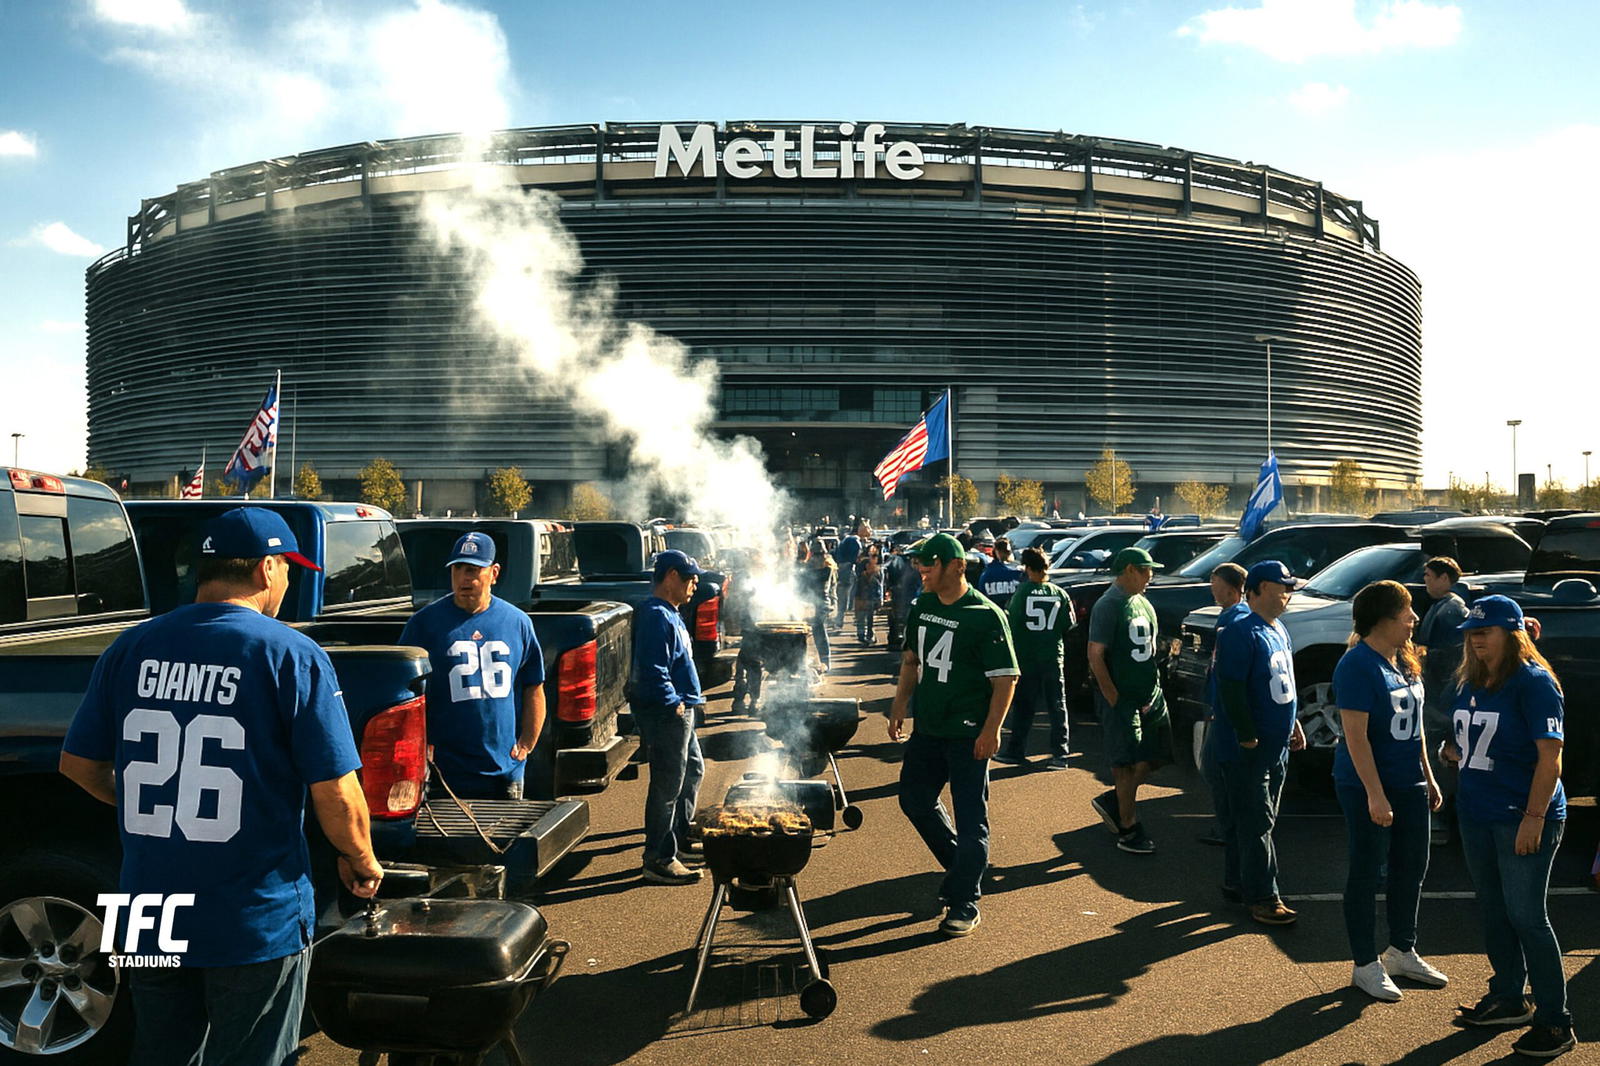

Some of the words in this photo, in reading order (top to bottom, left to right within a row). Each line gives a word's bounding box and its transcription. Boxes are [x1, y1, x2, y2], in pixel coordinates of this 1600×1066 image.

[654, 122, 925, 180] MetLife
[1026, 596, 1061, 631] 57
[137, 659, 242, 705] GIANTS
[447, 640, 512, 702] 26
[123, 708, 245, 842] 26
